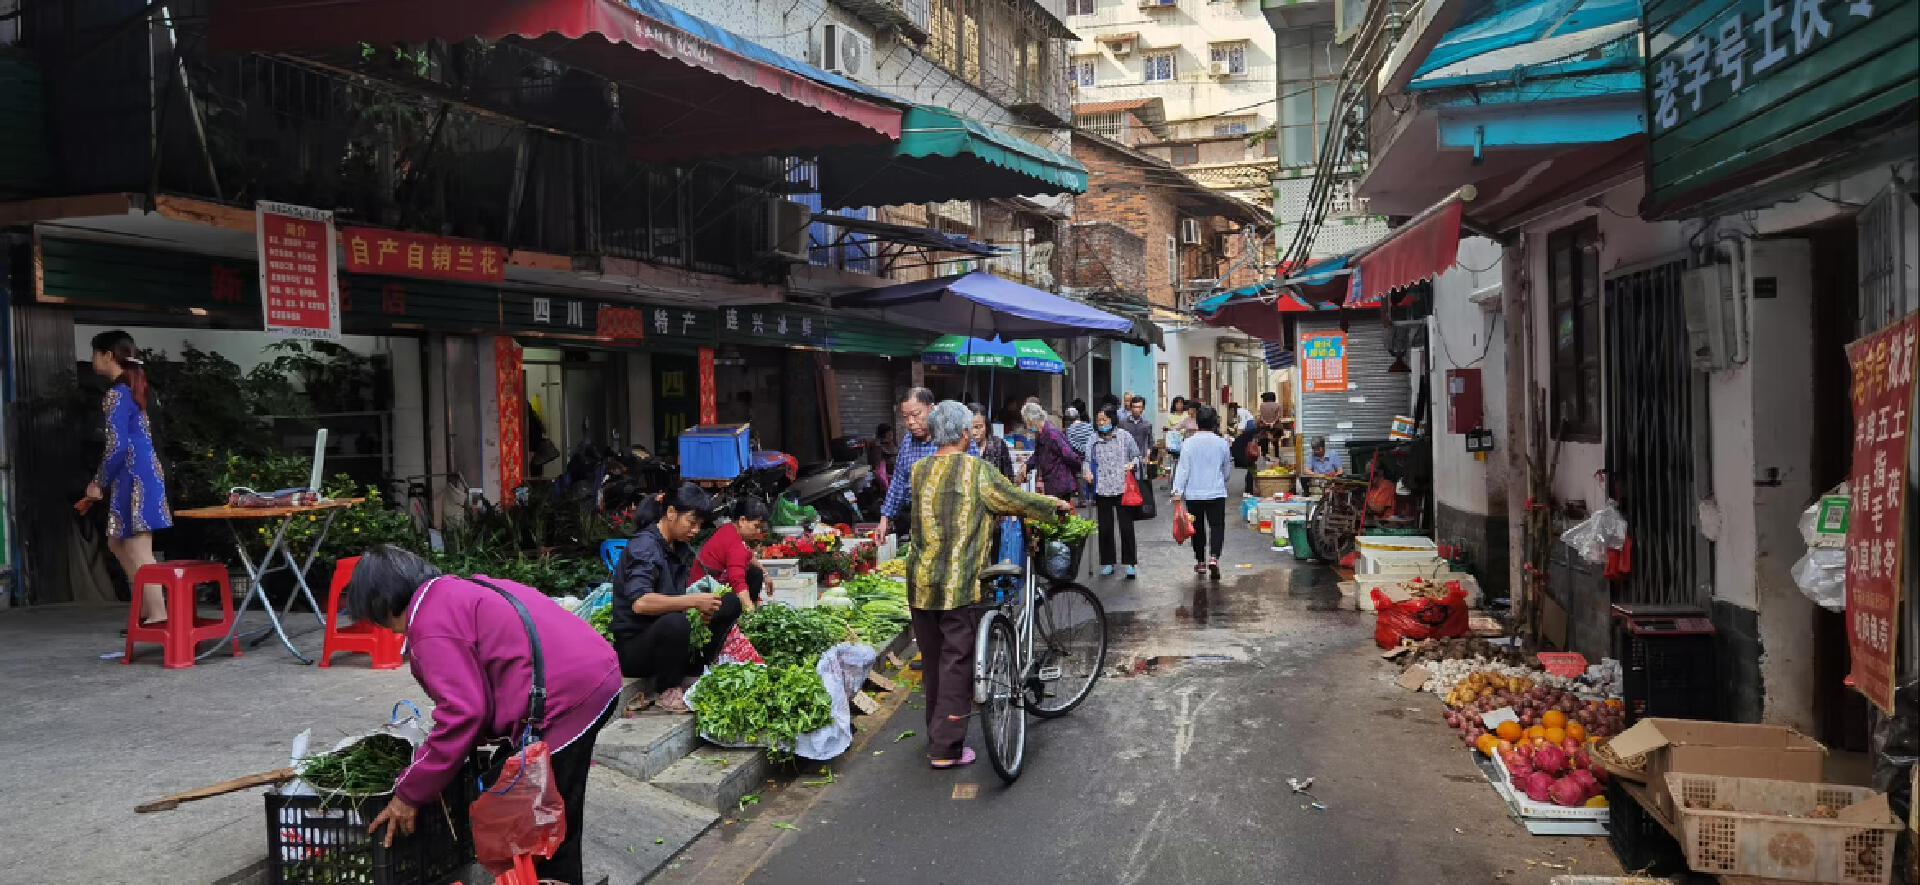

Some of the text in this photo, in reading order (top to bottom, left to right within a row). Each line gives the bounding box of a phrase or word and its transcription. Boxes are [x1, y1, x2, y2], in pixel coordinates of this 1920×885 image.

[351, 235, 498, 275] 自产自销兰花
